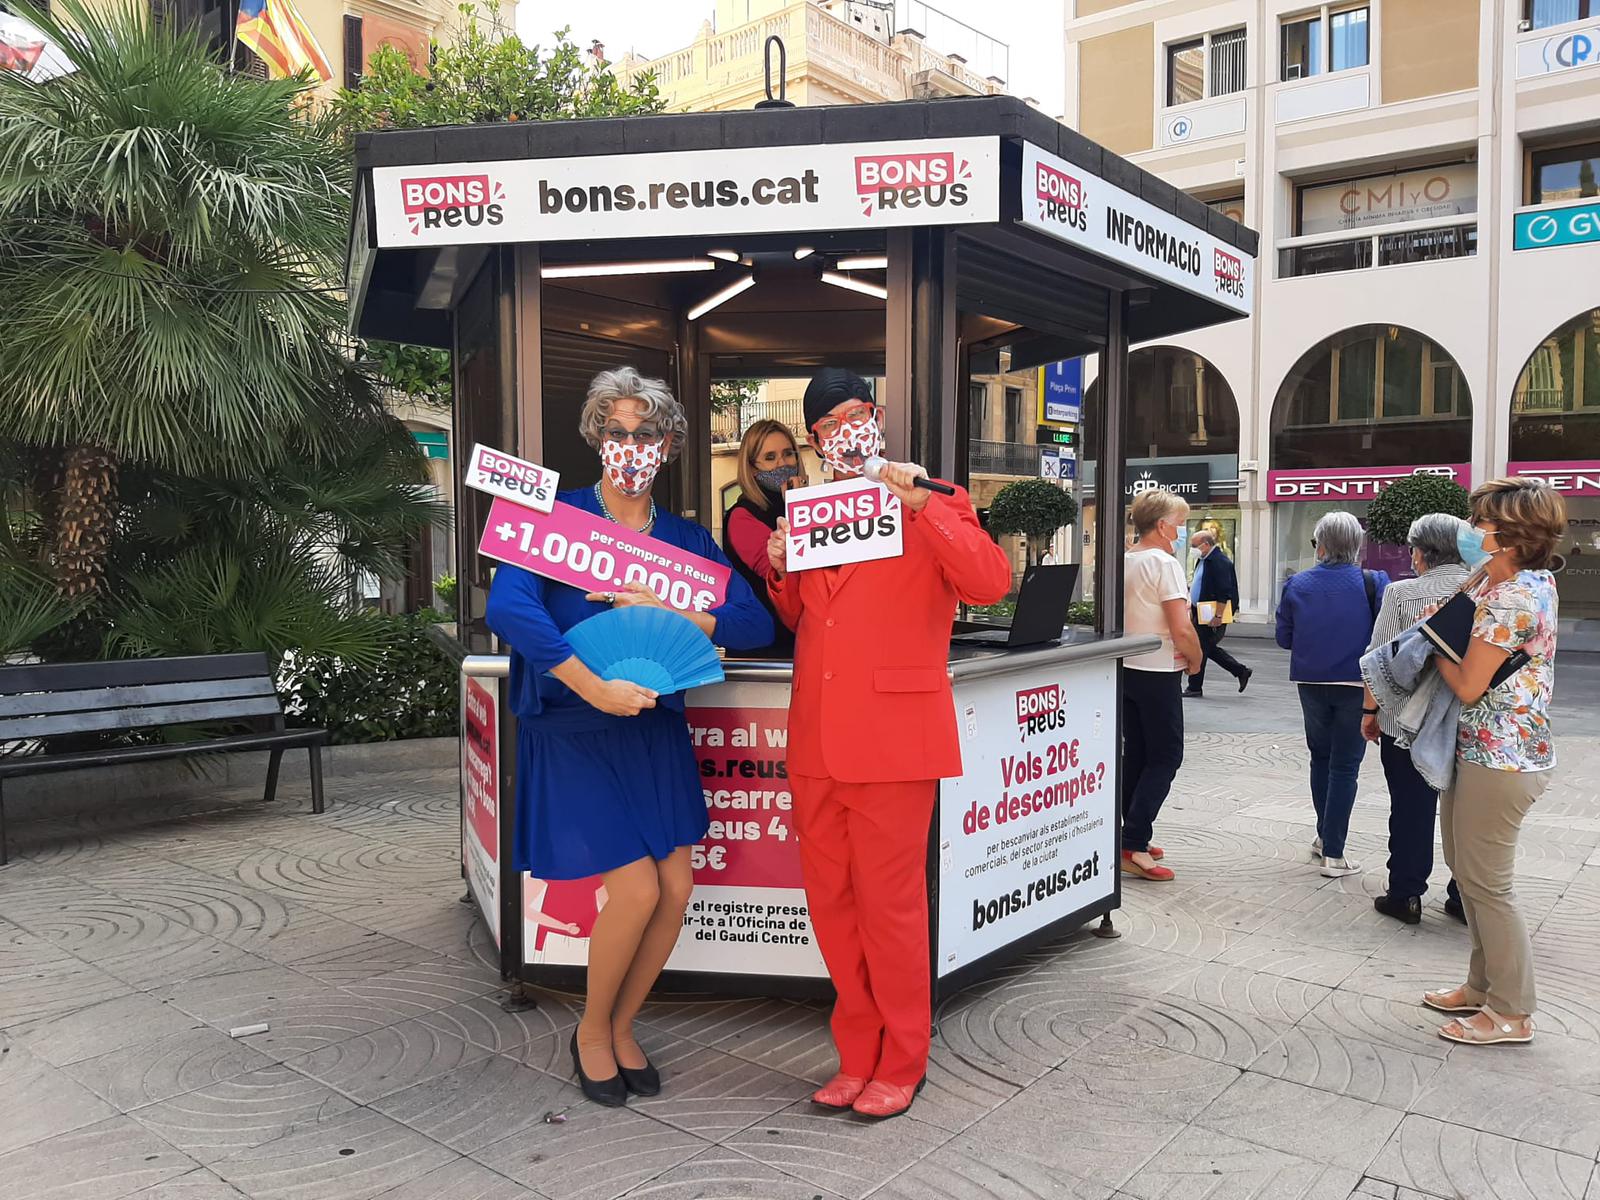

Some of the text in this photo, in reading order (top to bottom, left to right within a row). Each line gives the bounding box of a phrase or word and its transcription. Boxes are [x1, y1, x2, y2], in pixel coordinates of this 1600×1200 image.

[860, 158, 948, 187] BONS
[1038, 168, 1079, 207] BONS
[406, 181, 485, 207] BONS
[538, 169, 819, 214] bons.reus.cat
[1106, 206, 1201, 277] INFORMACIÓ
[1215, 253, 1240, 279] BONS
[480, 454, 539, 485] BONS
[1275, 480, 1393, 496] DENTI
[793, 495, 875, 528] BONS
[495, 521, 717, 612] +1.000.000€
[590, 531, 716, 586] per comprar a Reus
[1018, 690, 1057, 717] BONS
[731, 722, 757, 748] al
[697, 759, 788, 779] s.reus
[1001, 739, 1080, 788] Vols 20€
[963, 762, 1105, 836] de descompte?
[702, 816, 788, 842] eus 4
[986, 844, 999, 858] per
[1001, 829, 1039, 851] bescanviar
[1040, 824, 1050, 837] als
[965, 855, 1009, 879] comercials,
[1010, 848, 1021, 862] del
[1022, 841, 1043, 857] sector
[1044, 831, 1068, 848] serveis
[1022, 848, 1058, 871] de la ciutat
[972, 850, 1099, 932] bons.reus.cat
[693, 900, 810, 918] el registre prese
[718, 918, 726, 927] a
[729, 915, 786, 930] l'Oficina
[789, 919, 807, 931] de
[695, 929, 810, 945] del Gaudí Centre
